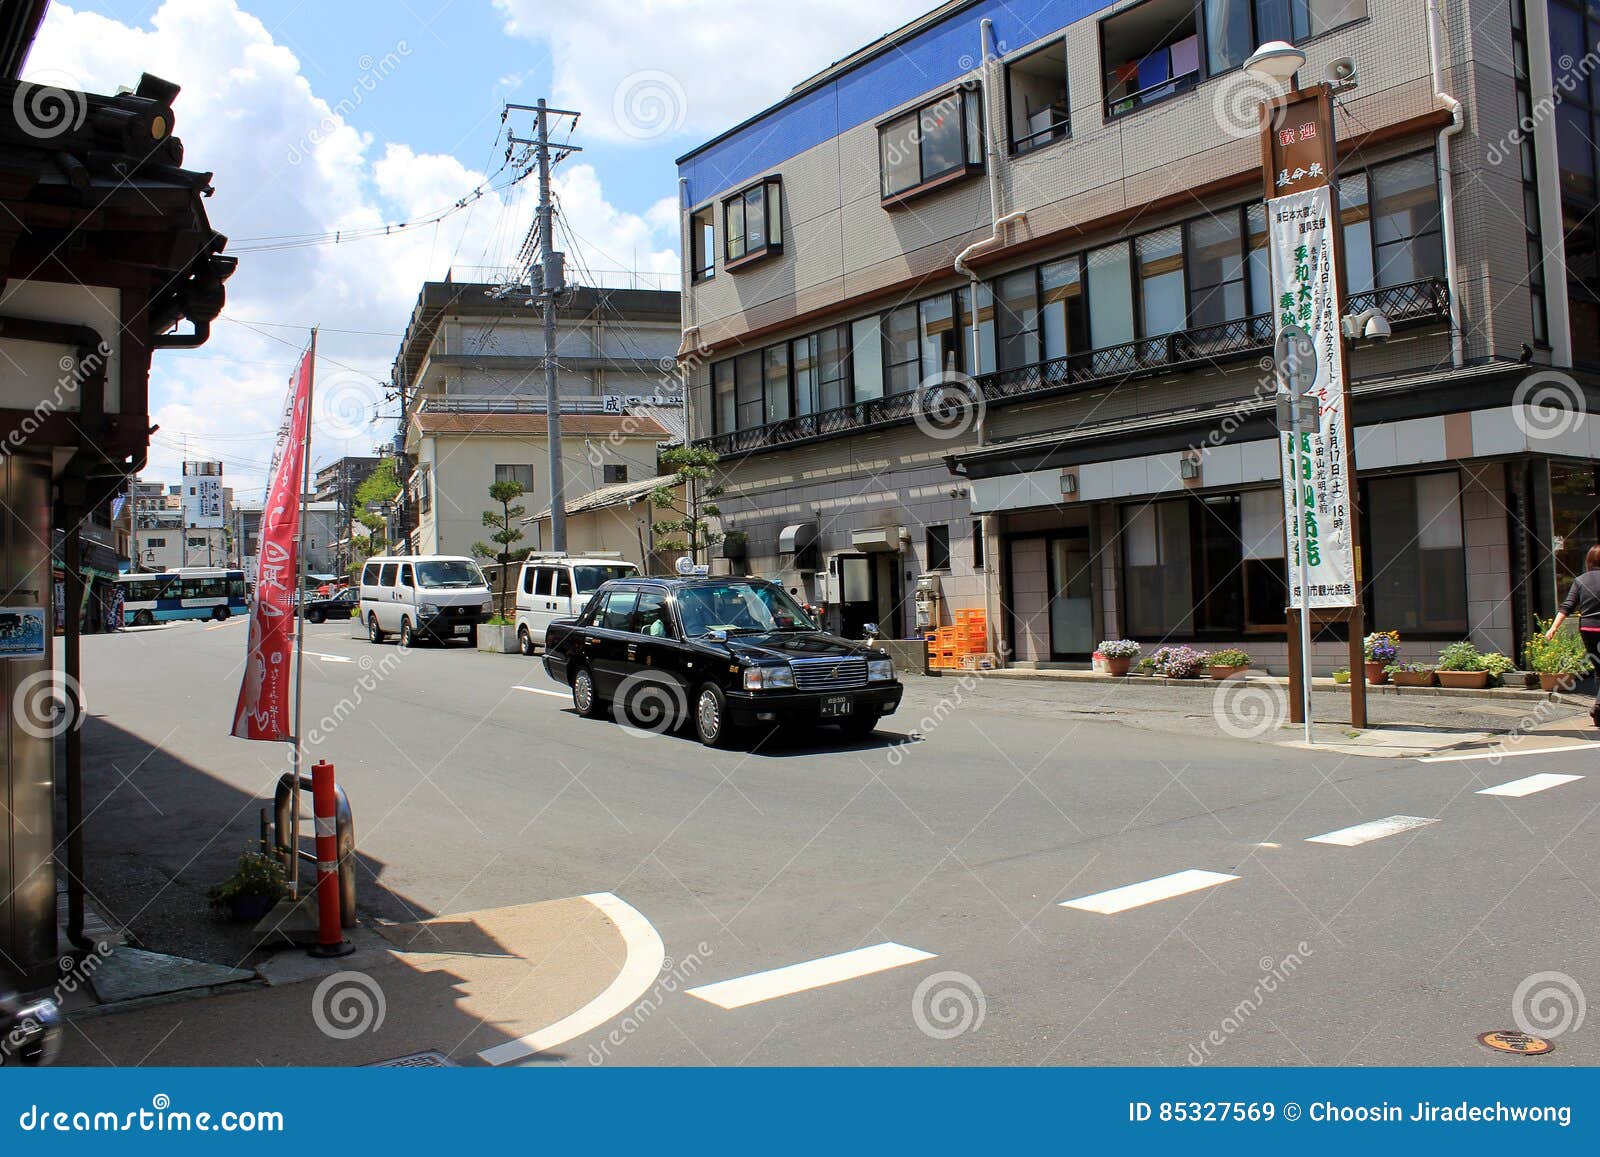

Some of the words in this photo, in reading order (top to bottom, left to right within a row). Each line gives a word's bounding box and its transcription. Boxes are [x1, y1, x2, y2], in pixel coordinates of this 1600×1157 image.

[1293, 584, 1351, 597] 成市観光協会
